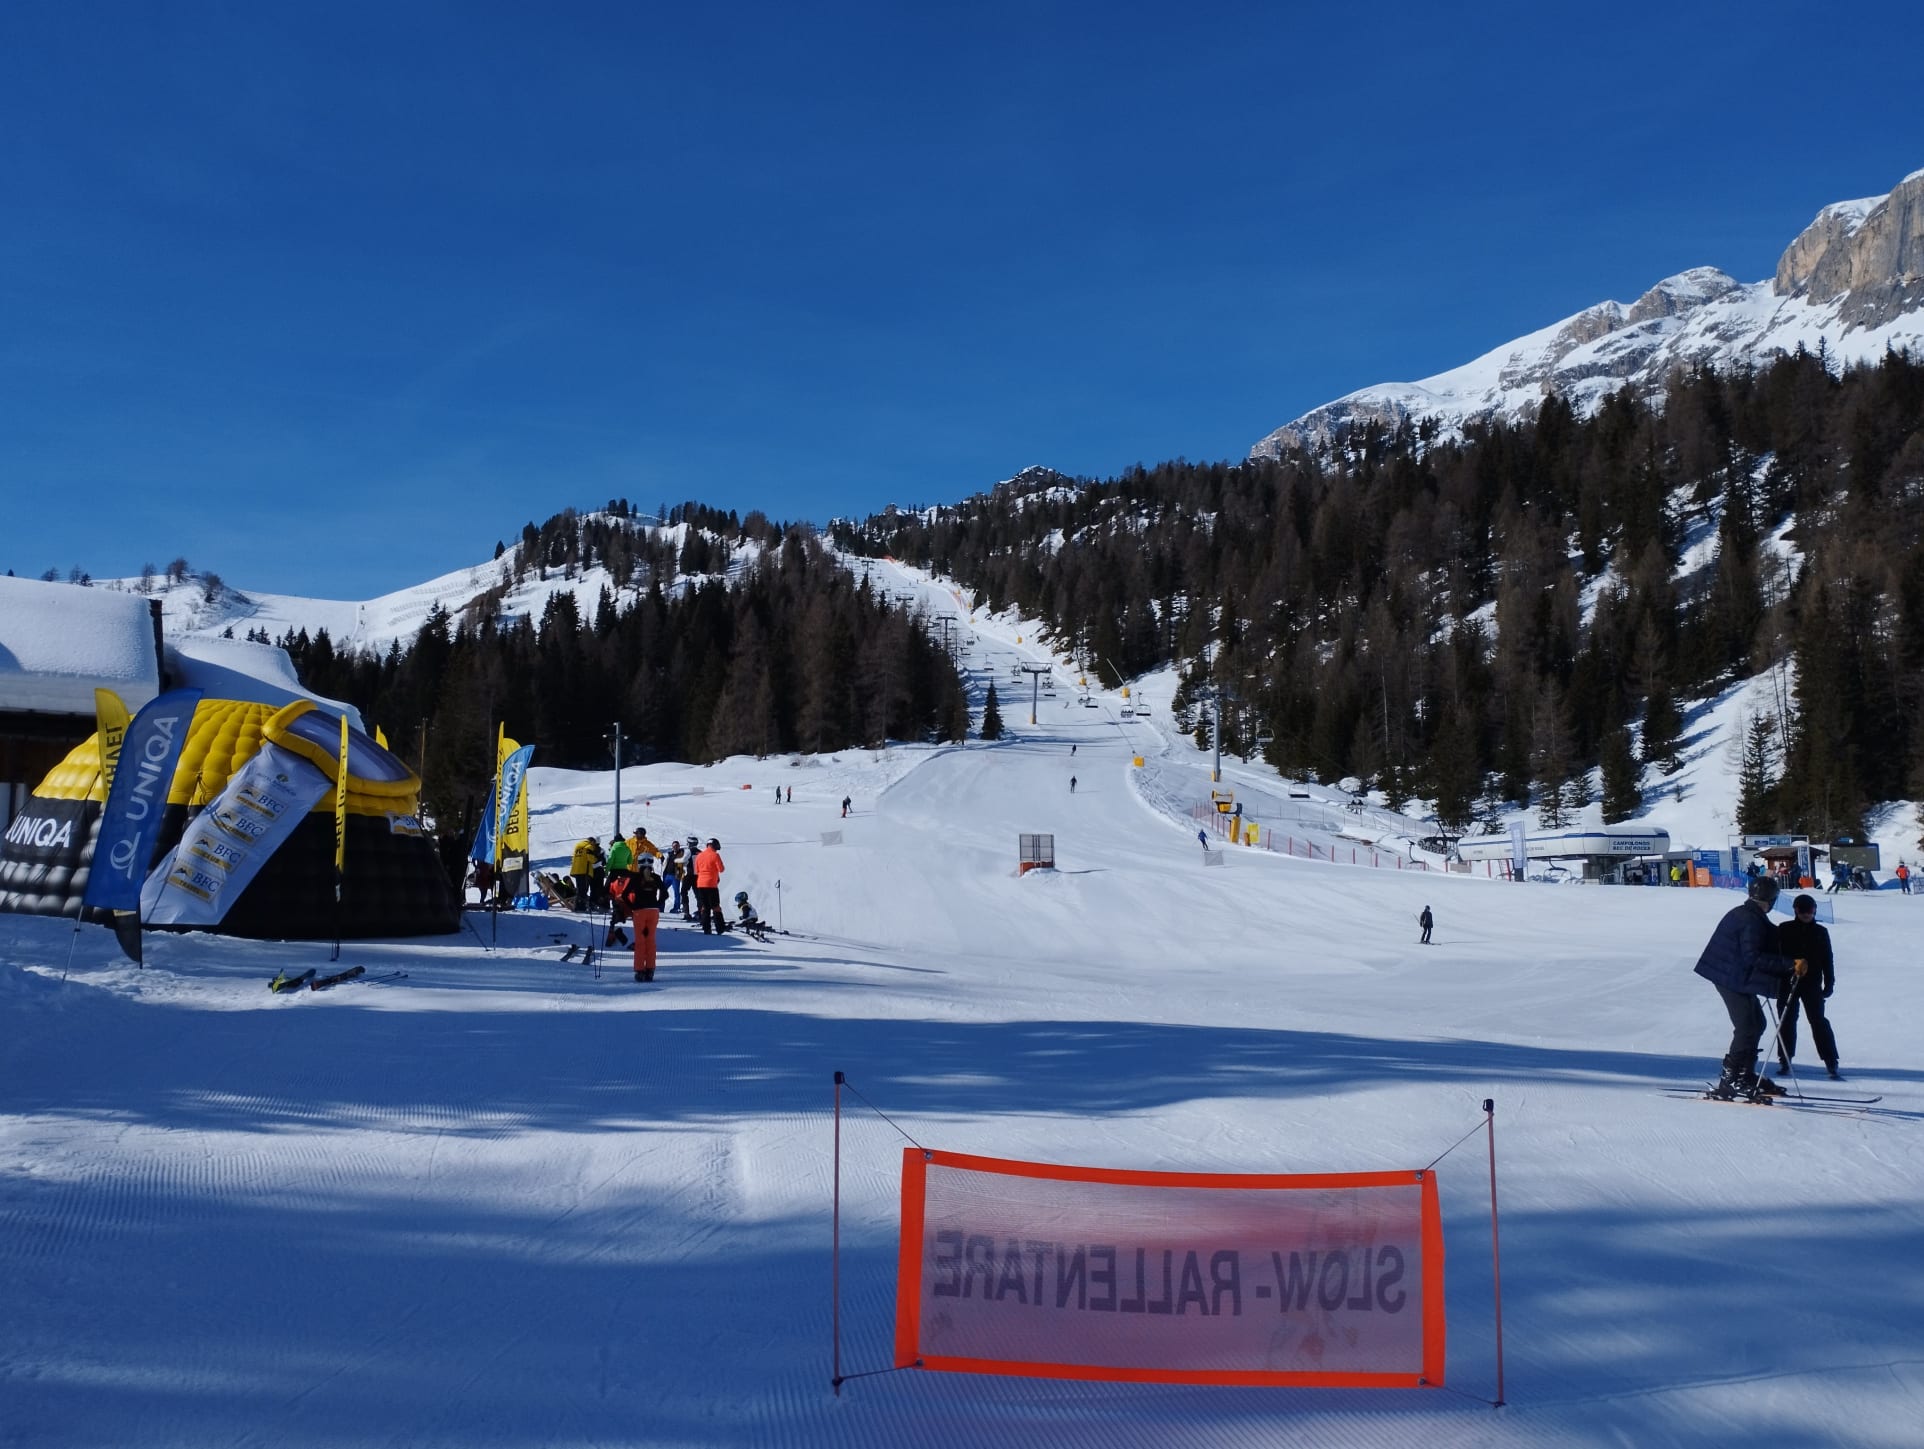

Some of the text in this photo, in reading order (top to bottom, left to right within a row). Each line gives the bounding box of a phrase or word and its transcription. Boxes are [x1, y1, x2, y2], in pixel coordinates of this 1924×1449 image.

[126, 716, 179, 821] UNIQA
[258, 794, 285, 813] BFC
[10, 815, 72, 848] UNIQA
[236, 817, 264, 837] BFC
[214, 843, 241, 864] BFC
[192, 872, 220, 893] BFC
